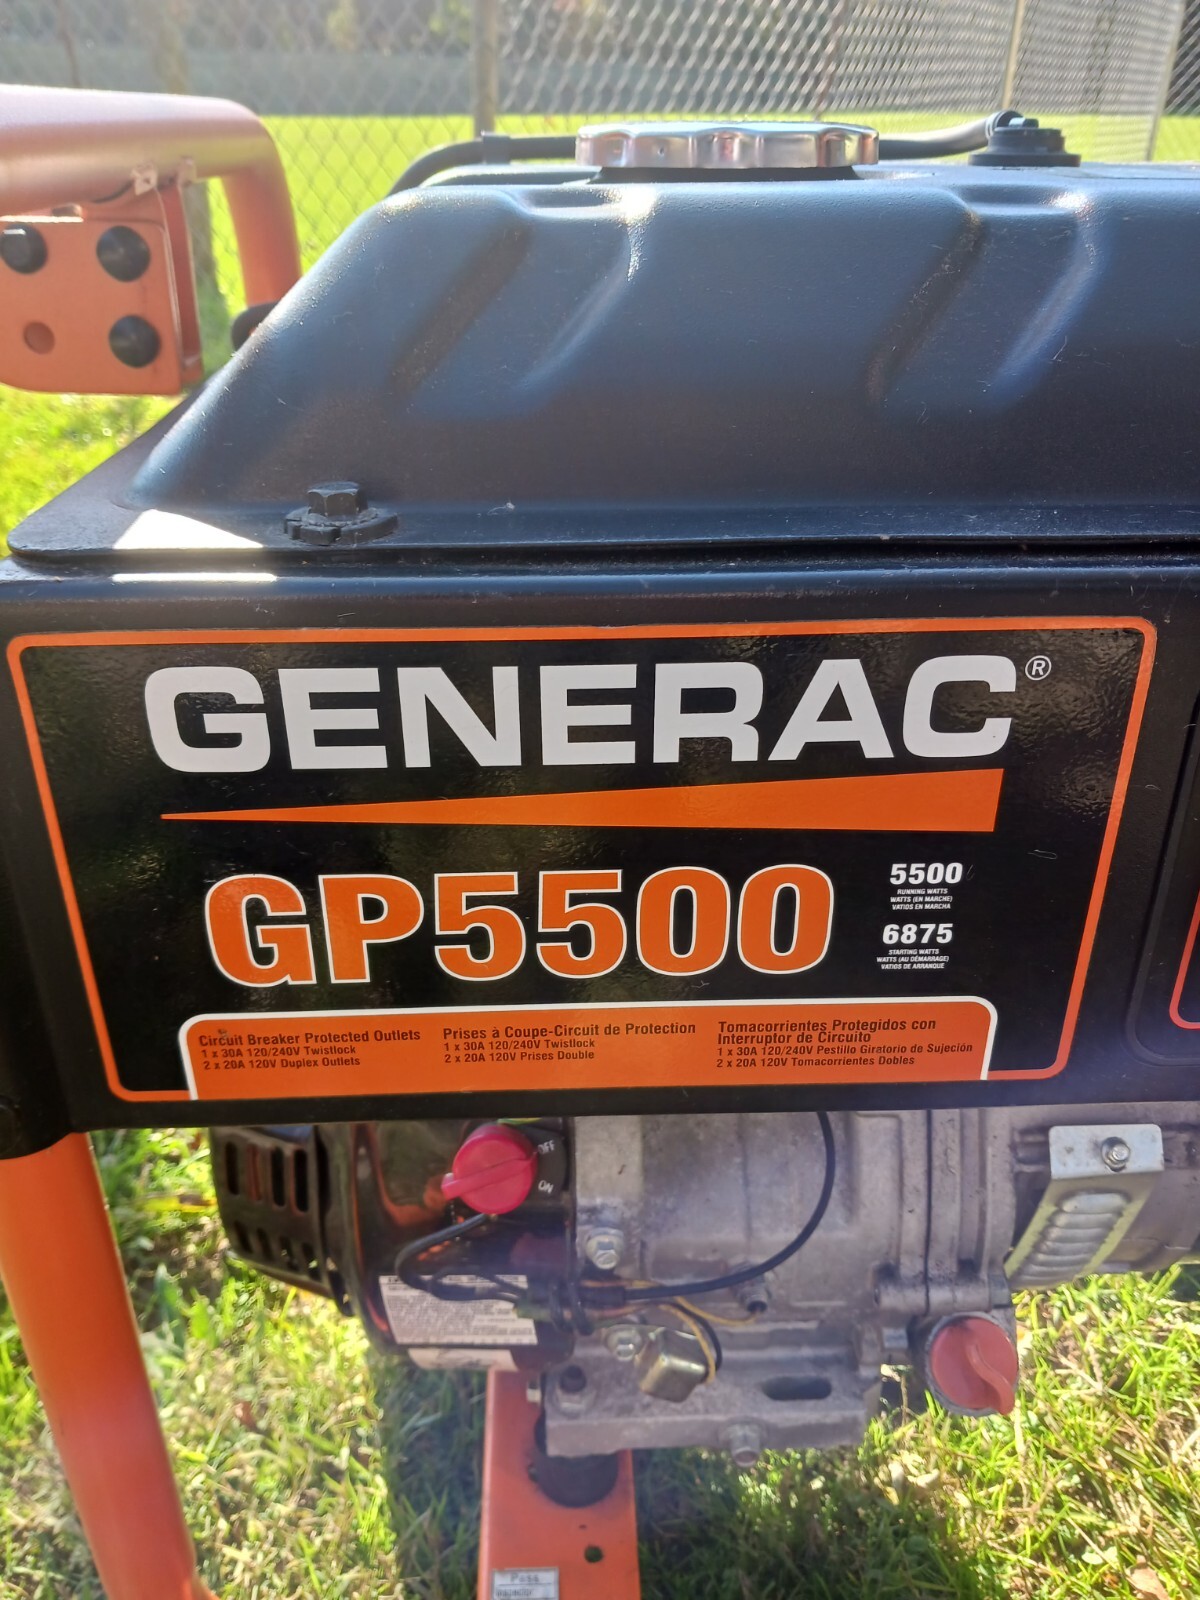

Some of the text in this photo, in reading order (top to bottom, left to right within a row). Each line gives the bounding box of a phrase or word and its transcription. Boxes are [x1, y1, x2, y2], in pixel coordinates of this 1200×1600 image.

[144, 655, 1017, 773] GENERAC
[890, 862, 963, 885] 5500
[204, 864, 835, 988] GP5500
[882, 923, 953, 944] 6875
[444, 1023, 696, 1039] Prises à Coupe-Circuit de Protection
[718, 1019, 936, 1033] Tomacorrientes Protegidos con
[199, 1029, 421, 1047] Circuit Breaker Protected Outlets
[444, 1042, 450, 1051] 1
[464, 1042, 484, 1050] 30A
[489, 1040, 540, 1050] 120/240V
[544, 1039, 595, 1049] Twistlock
[718, 1031, 871, 1046] Interruptor de Circuito
[201, 1049, 207, 1058] 1
[222, 1048, 243, 1058] 30A
[248, 1046, 300, 1057] 120/240V
[304, 1045, 356, 1055] Twistlock
[718, 1048, 723, 1056] 1
[737, 1047, 757, 1055] 30A
[762, 1046, 812, 1055] 120/240V
[817, 1045, 856, 1054] Pestillo
[860, 1045, 907, 1054] Giratorio
[910, 1044, 923, 1053] de
[927, 1043, 973, 1055] Sujeción
[203, 1057, 360, 1070] 2 x 20A 120V Duplex Outlets
[444, 1054, 451, 1063] 2
[465, 1053, 485, 1063] 20A
[490, 1052, 516, 1062] 120V
[521, 1052, 554, 1061] Prises
[558, 1051, 595, 1060] Double
[717, 1059, 723, 1068] 2
[736, 1058, 757, 1067] 20A
[761, 1058, 788, 1067] 120V
[791, 1056, 875, 1066] Tomacorrientes
[879, 1055, 915, 1065] Dobles
[538, 1140, 555, 1154] OFF
[538, 1180, 554, 1194] ON
